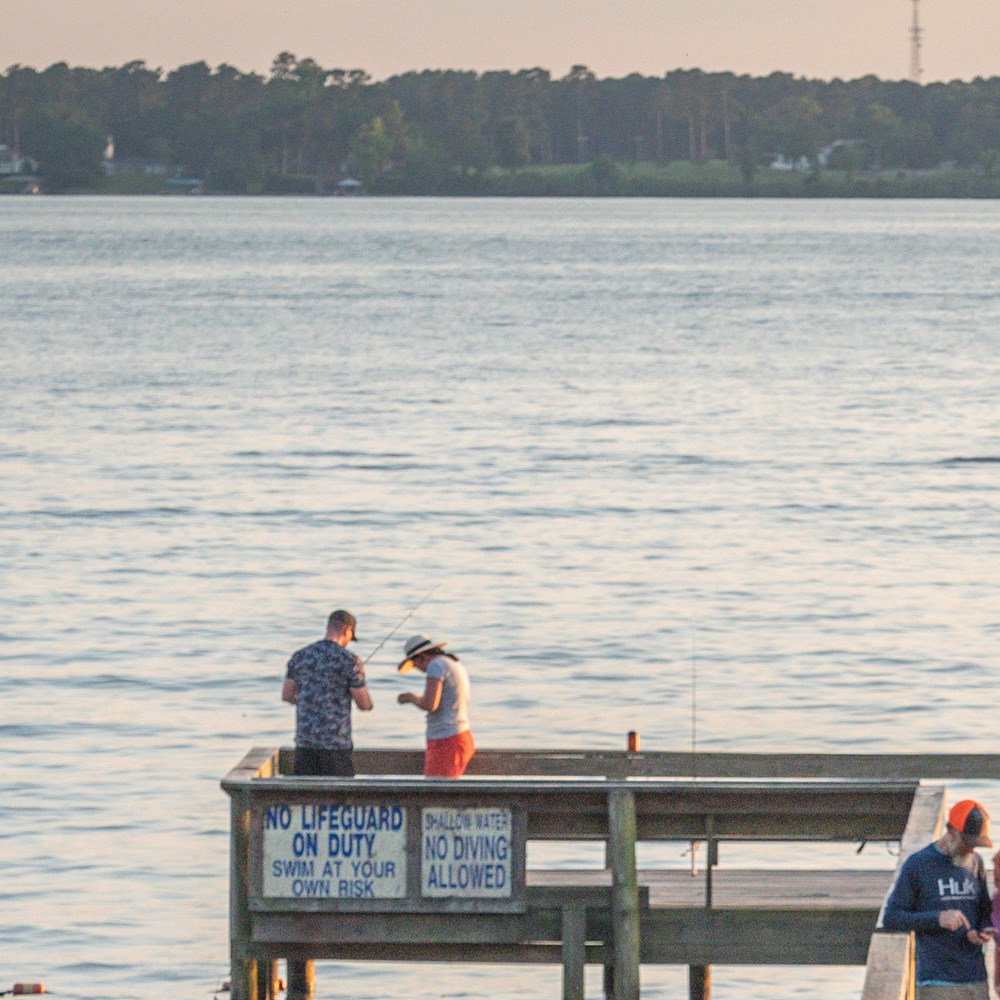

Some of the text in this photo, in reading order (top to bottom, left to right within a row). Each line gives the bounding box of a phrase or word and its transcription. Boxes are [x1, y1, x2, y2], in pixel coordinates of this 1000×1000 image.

[266, 806, 403, 831] NO LIFEGUARD
[425, 812, 507, 830] SHALLOW WATER
[292, 833, 376, 857] ON DUTY
[425, 836, 507, 860] NO DIVING
[272, 860, 396, 878] SWIM AT YOUR
[428, 864, 506, 889] ALLOWED
[291, 880, 375, 898] OWN RISK
